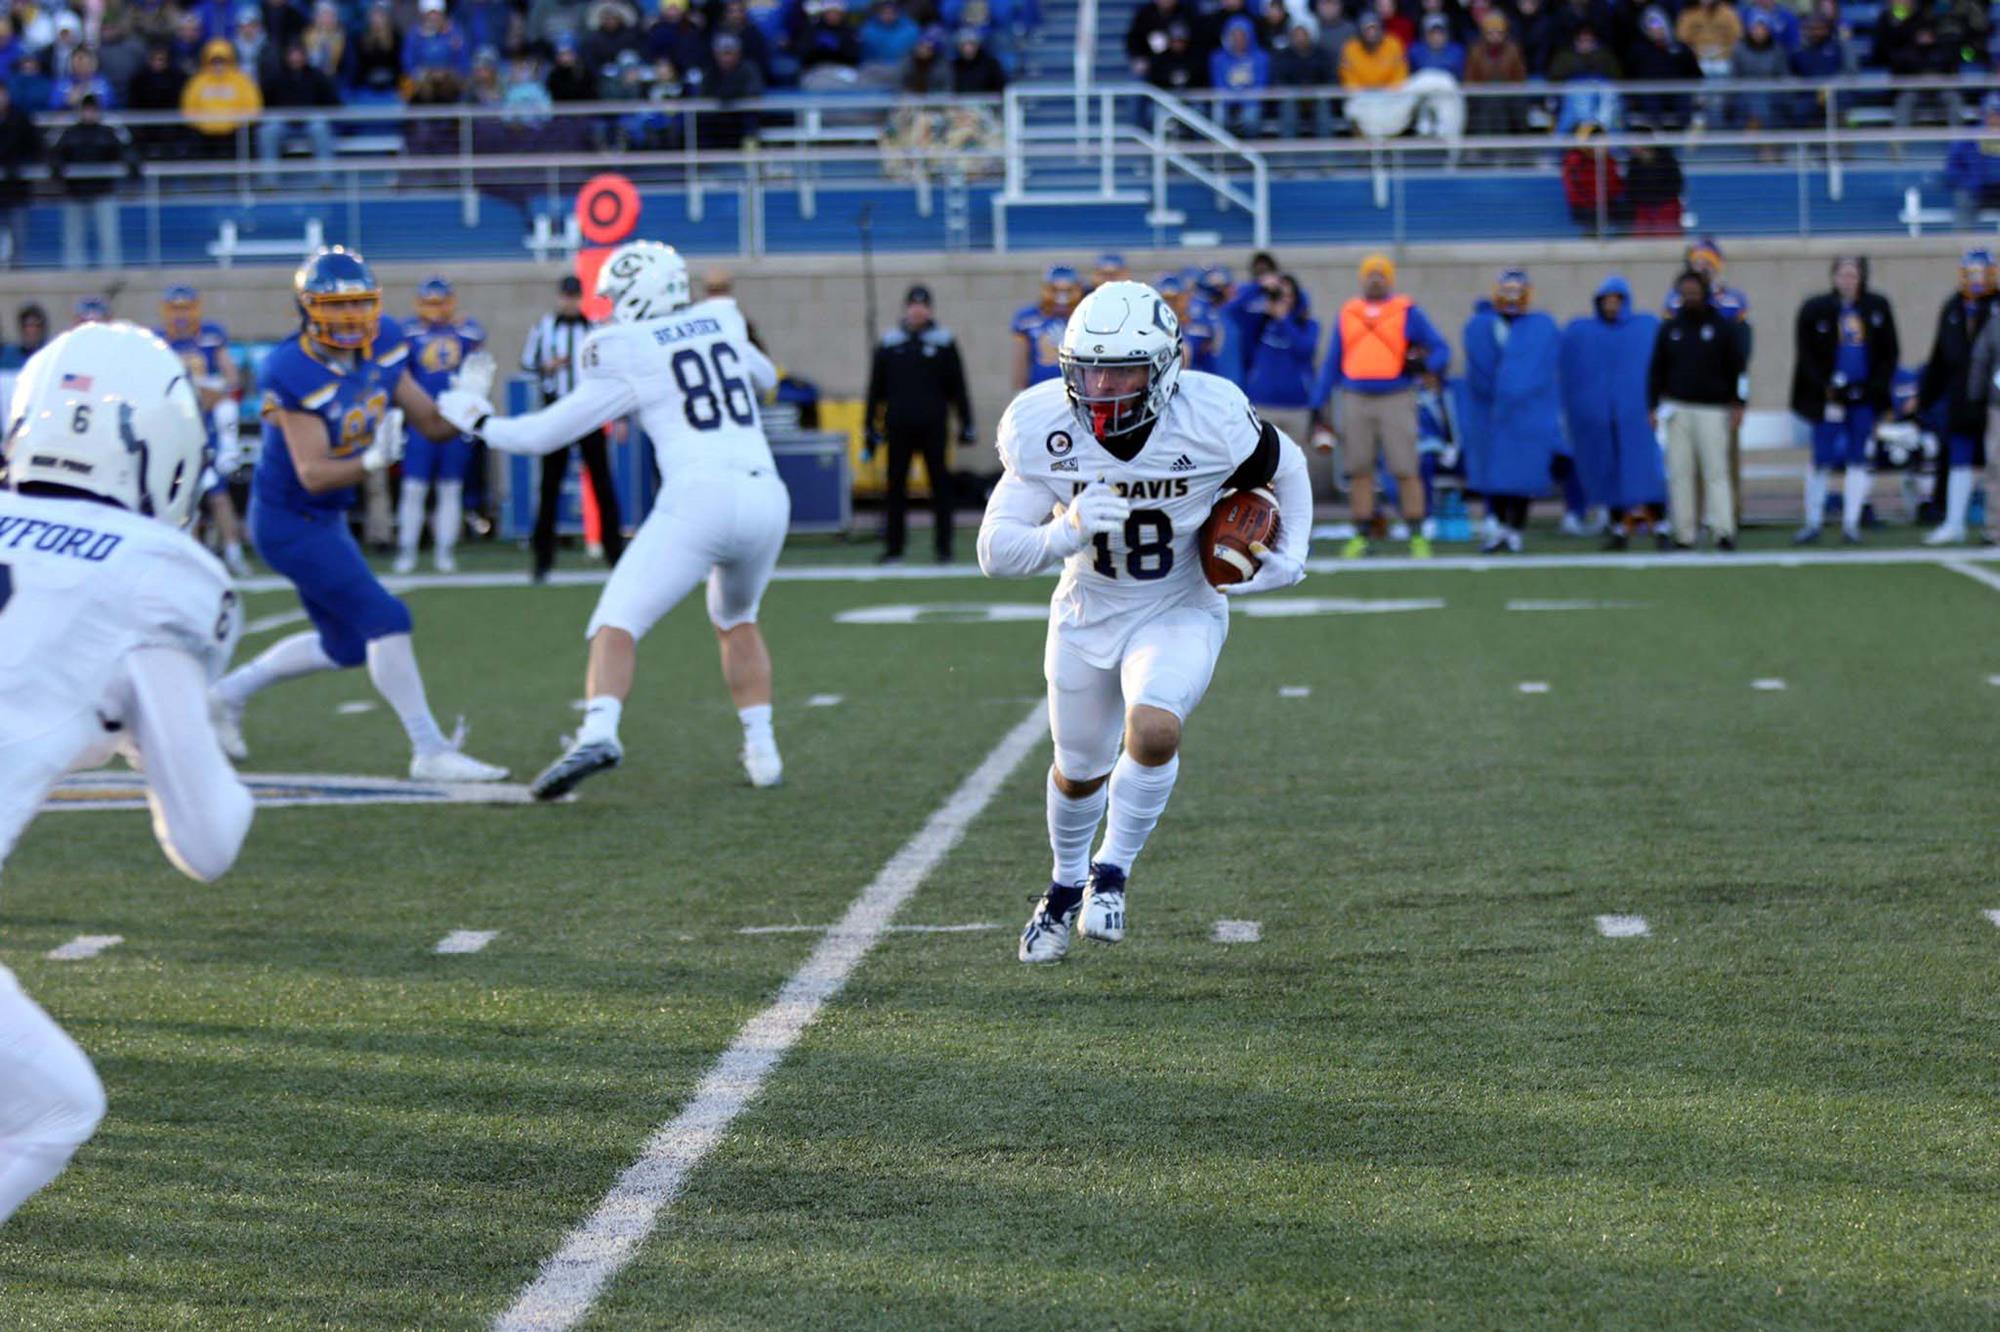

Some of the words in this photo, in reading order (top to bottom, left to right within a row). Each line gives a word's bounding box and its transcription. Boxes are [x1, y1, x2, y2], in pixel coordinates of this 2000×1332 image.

[672, 341, 754, 431] 86
[73, 404, 93, 434] 6
[1117, 478, 1188, 499] DAVIS
[1092, 507, 1173, 580] 18
